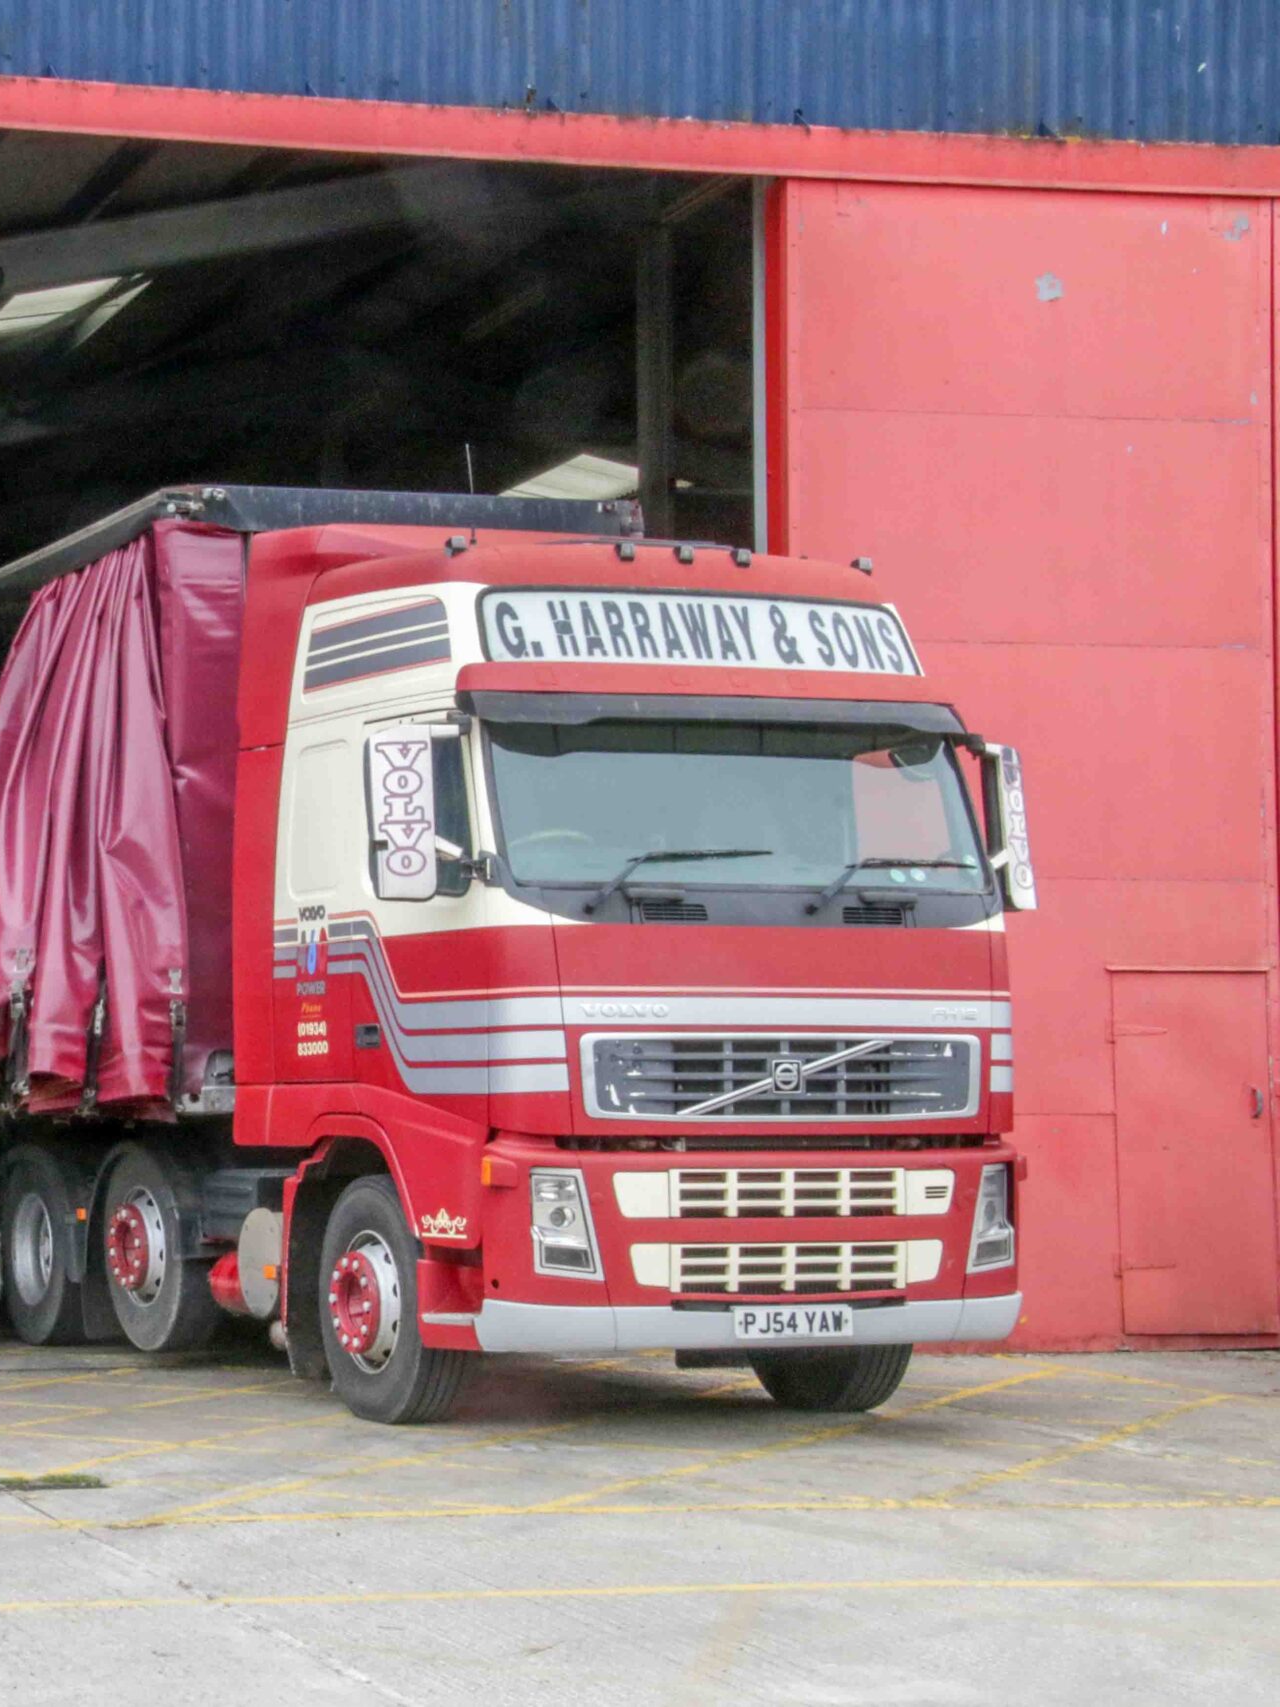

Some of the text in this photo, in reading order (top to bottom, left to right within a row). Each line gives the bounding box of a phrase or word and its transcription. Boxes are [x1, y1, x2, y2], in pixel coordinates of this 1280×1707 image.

[496, 600, 903, 673] G. HARRAWAY & SONS
[375, 741, 431, 877] VOLVO
[296, 980, 326, 996] POWER
[580, 1003, 670, 1018] VOLVO
[297, 1021, 327, 1037] (01934)
[297, 1040, 329, 1057] 833000
[743, 1310, 843, 1335] PJ54 YAW
